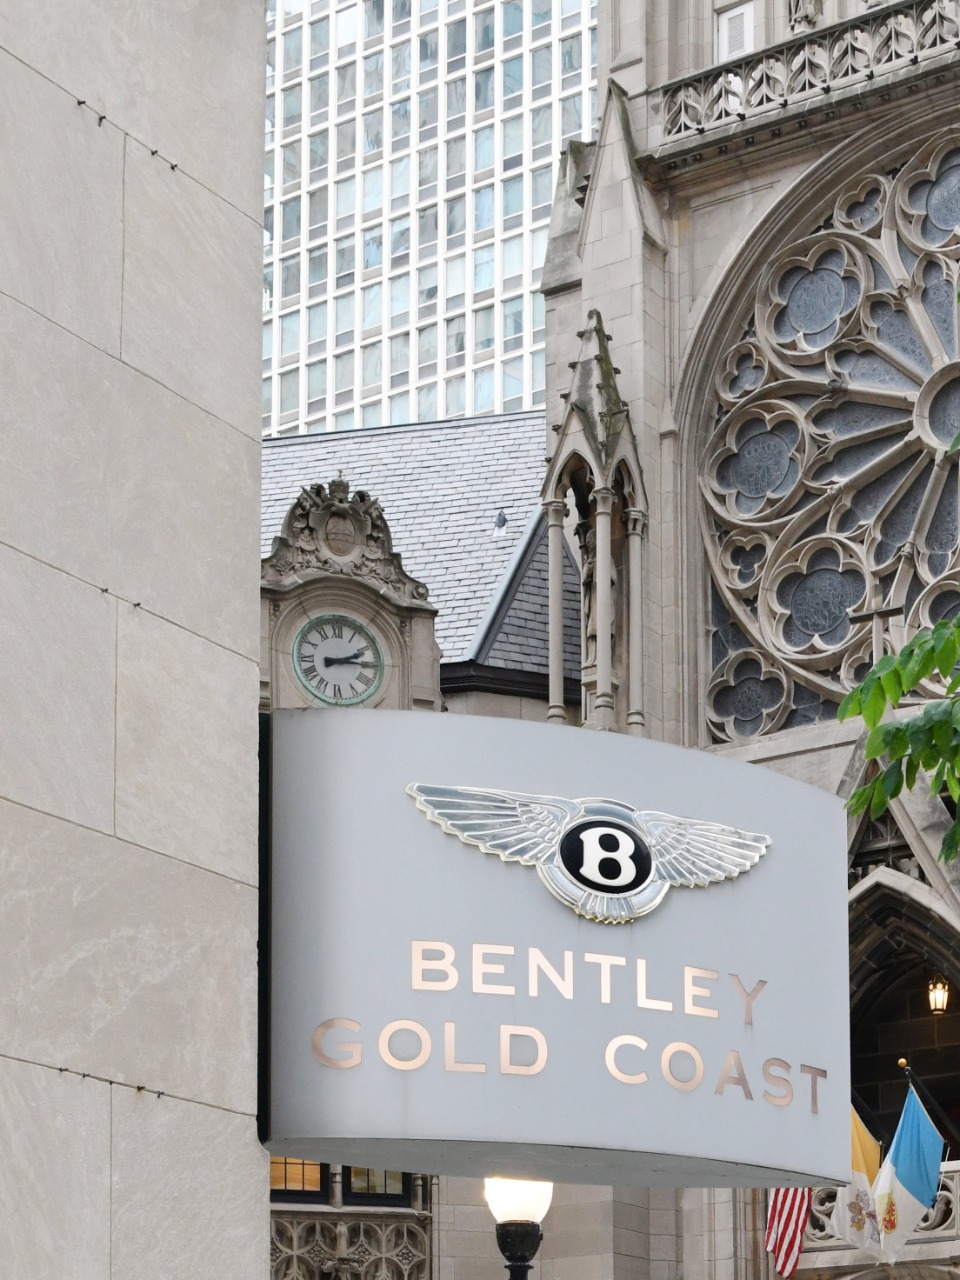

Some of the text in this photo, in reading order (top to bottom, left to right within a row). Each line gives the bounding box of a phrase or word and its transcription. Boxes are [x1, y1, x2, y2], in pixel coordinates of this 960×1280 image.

[331, 624, 343, 639] XII
[579, 826, 637, 887] B
[411, 940, 768, 1026] BENTLEY
[311, 1017, 828, 1115] GOLD COAST
